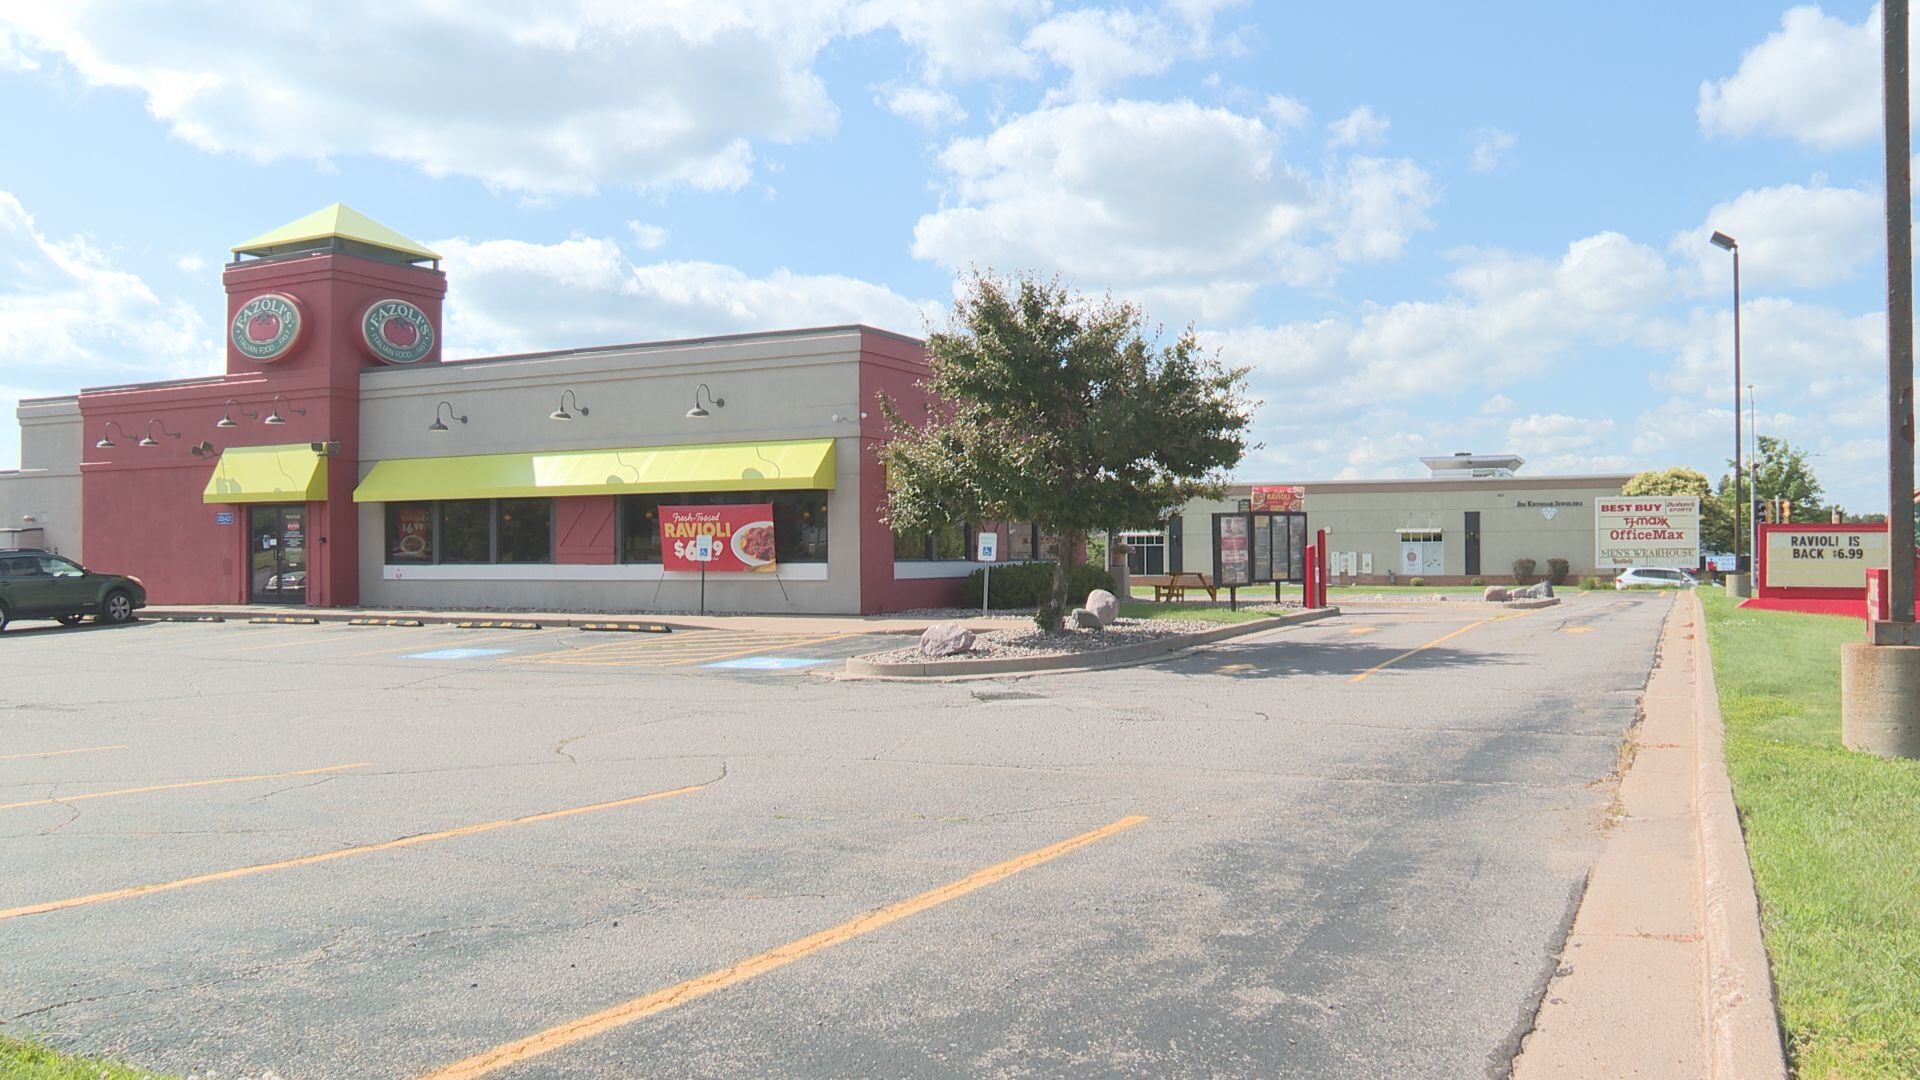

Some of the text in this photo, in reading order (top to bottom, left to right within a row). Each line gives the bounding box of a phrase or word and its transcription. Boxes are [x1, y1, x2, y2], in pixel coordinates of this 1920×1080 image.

[1601, 504, 1663, 512] BEST BUY
[664, 522, 731, 538] RAVIOLI
[1610, 529, 1684, 540] OfficeMax
[1790, 536, 1861, 547] RAVIOLI IS
[1633, 549, 1695, 558] WEARHOUSE
[1792, 548, 1864, 559] BACK $6.99
